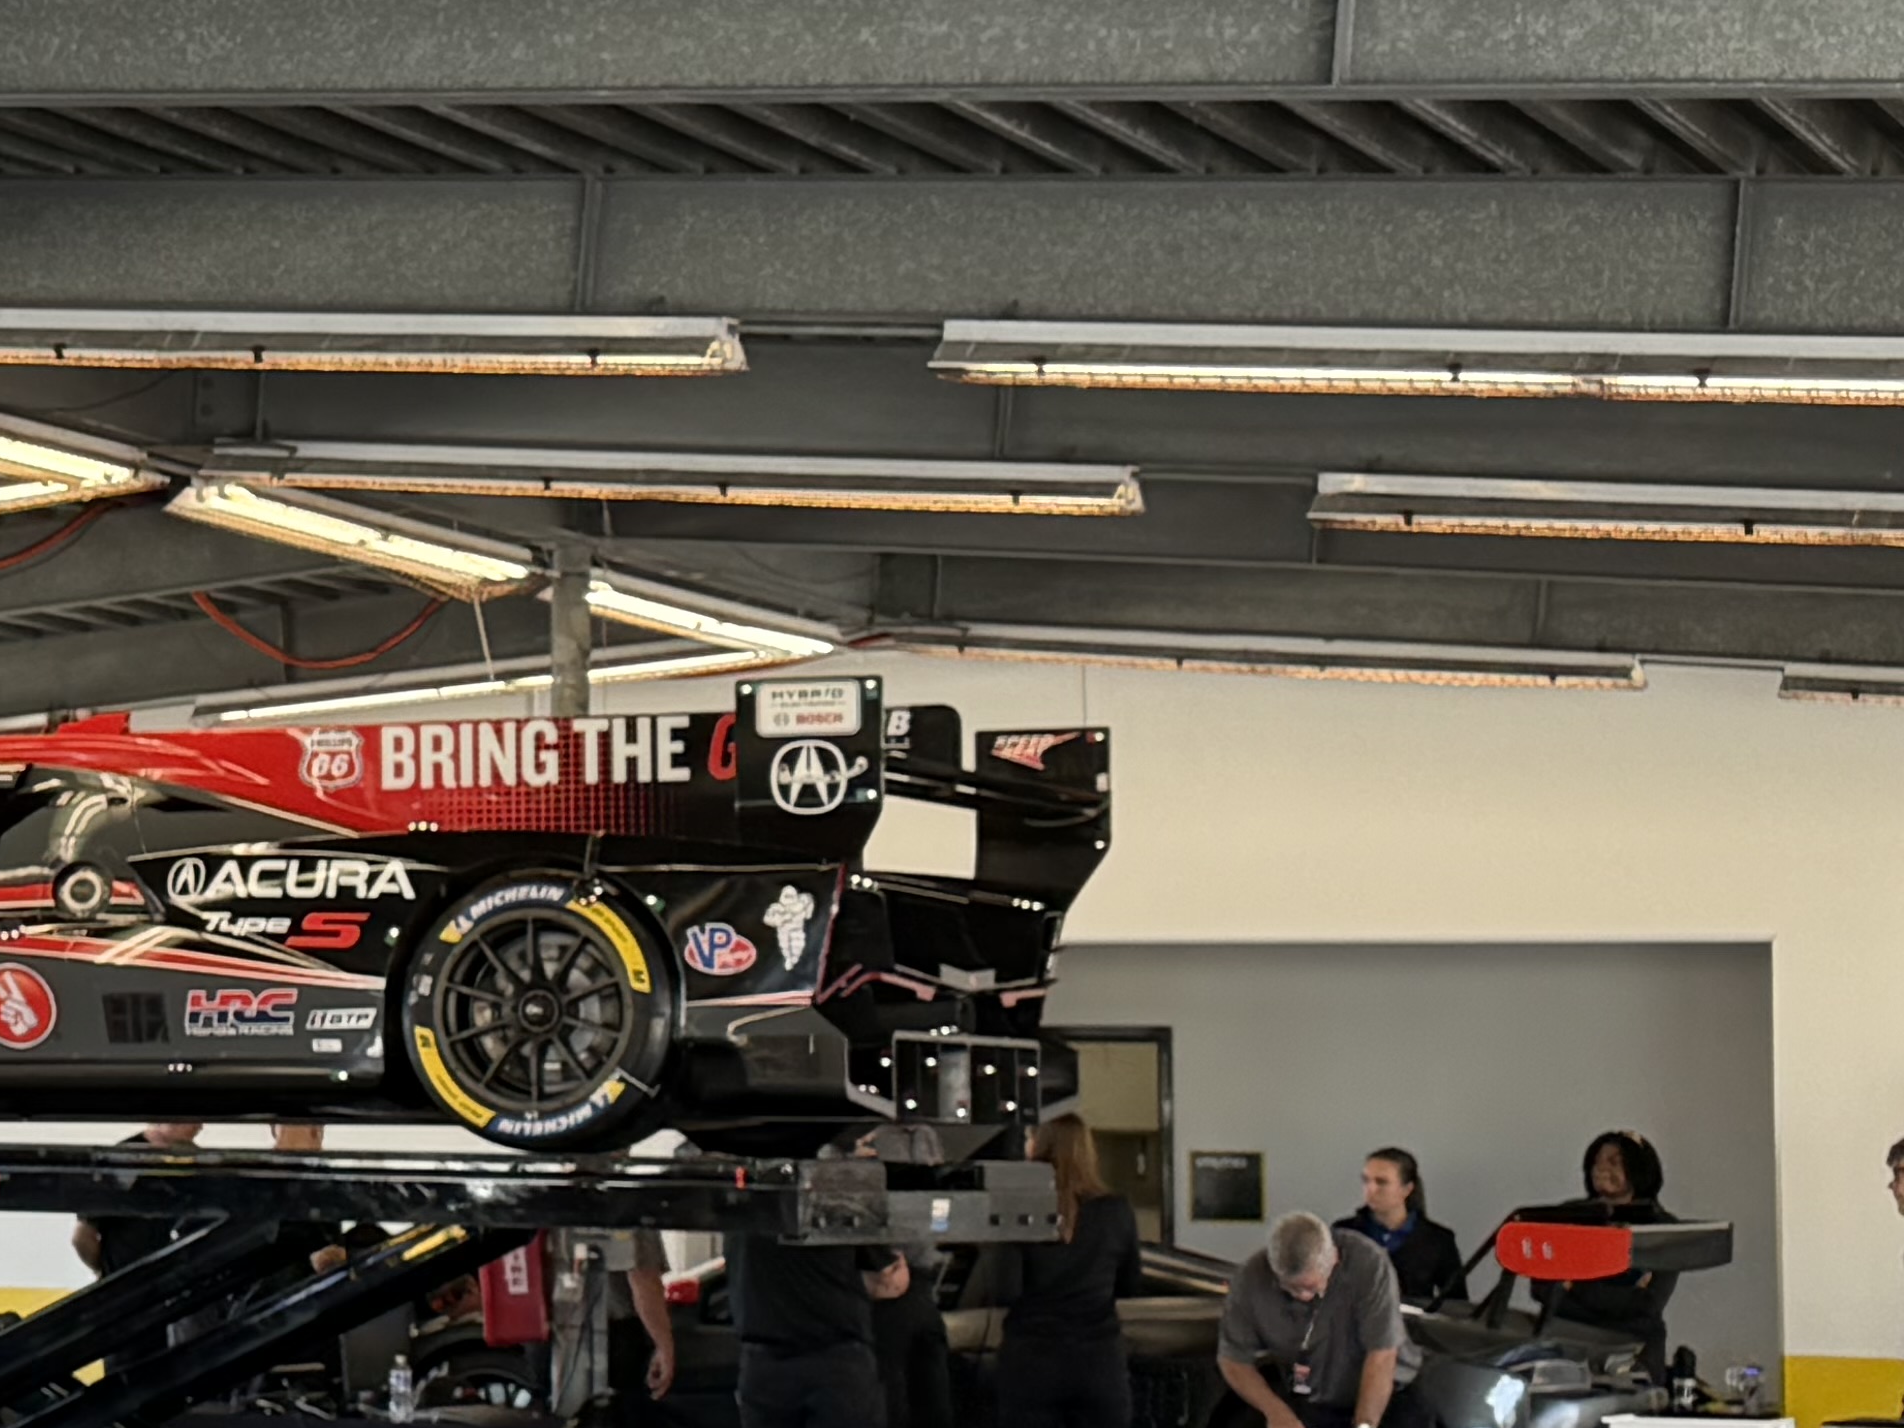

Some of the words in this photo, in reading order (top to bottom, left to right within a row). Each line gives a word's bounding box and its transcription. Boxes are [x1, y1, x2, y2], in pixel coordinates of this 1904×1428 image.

[381, 720, 559, 791] BRING
[572, 715, 691, 785] THE
[202, 859, 417, 900] ACURA
[469, 884, 566, 920] MICHELIN
[201, 910, 292, 936] Type
[284, 911, 371, 950] S
[691, 927, 732, 970] VP
[185, 988, 298, 1025] HRC
